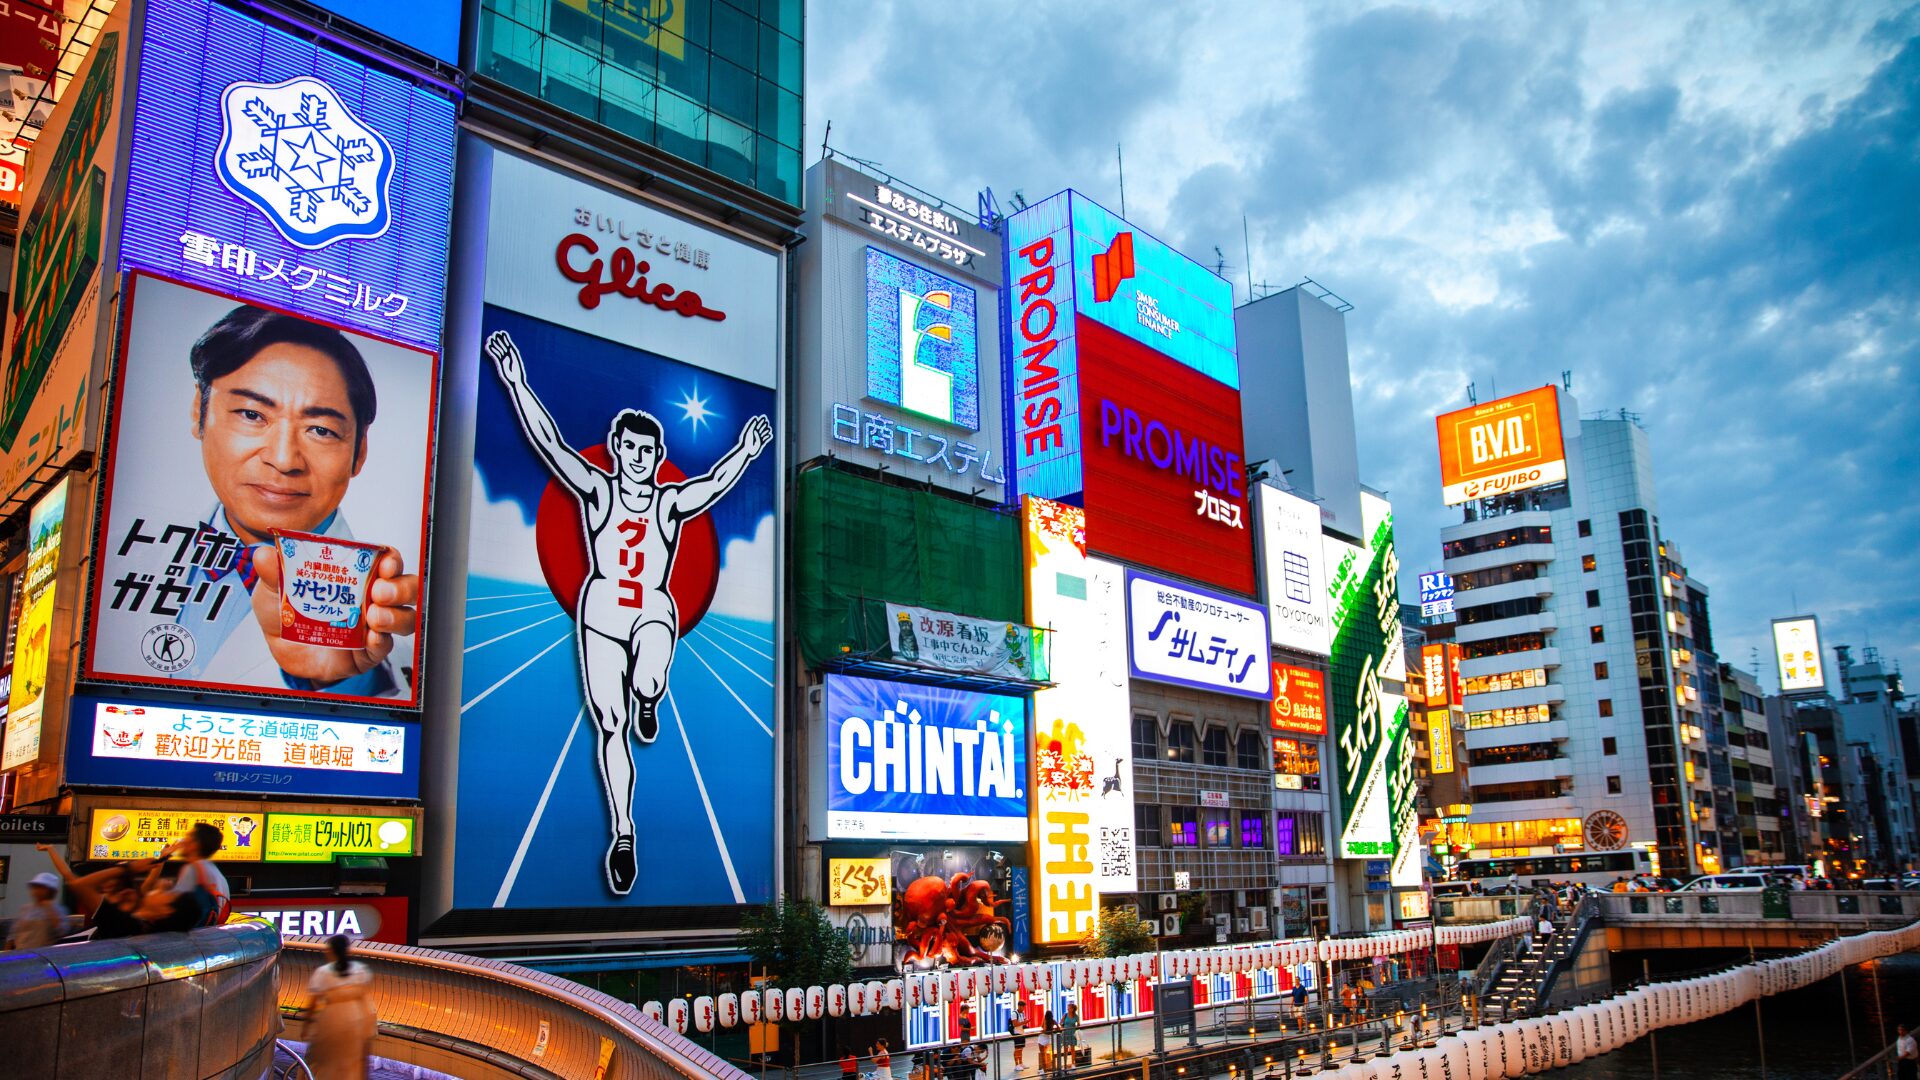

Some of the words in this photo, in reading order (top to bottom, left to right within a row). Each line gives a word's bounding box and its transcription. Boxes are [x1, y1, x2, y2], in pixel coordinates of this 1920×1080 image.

[877, 184, 960, 235] 夢ある住まい
[575, 206, 711, 271] おいしさと健康
[179, 230, 409, 318] 雪印メグミルク
[556, 233, 727, 322] Glico
[1136, 289, 1159, 310] SMBC
[1136, 301, 1181, 333] CONSUMER
[1137, 313, 1173, 339] FINANCE
[1019, 237, 1064, 456] PROMISE
[831, 402, 1006, 484] 日商エステム
[1100, 399, 1242, 497] PROMISE
[1483, 469, 1541, 491] FUJIBO
[1193, 489, 1244, 530] プロミス
[116, 518, 238, 570] トクホ
[319, 546, 334, 560] 恵
[165, 564, 186, 577] の
[296, 568, 358, 586] 減らすのを助ける
[617, 517, 649, 609] グリコ
[110, 571, 231, 621] ガセリ
[292, 579, 340, 602] ガセリ
[1157, 590, 1250, 622] 総合不動産のプロデューサー
[303, 602, 343, 617] ヨーグルト
[1276, 604, 1324, 628] TOYOTOMI
[919, 615, 991, 644] 改源看板
[1168, 628, 1239, 668] サムティ
[172, 713, 340, 741] ようこそ道頓堀へ
[155, 733, 262, 762] 歡迎光臨
[284, 742, 354, 767] 道頓堀
[213, 770, 293, 785] 雪印メグミルク
[1, 818, 45, 831] oilets
[315, 821, 373, 847] ピタットハウス
[842, 865, 879, 897] くくる
